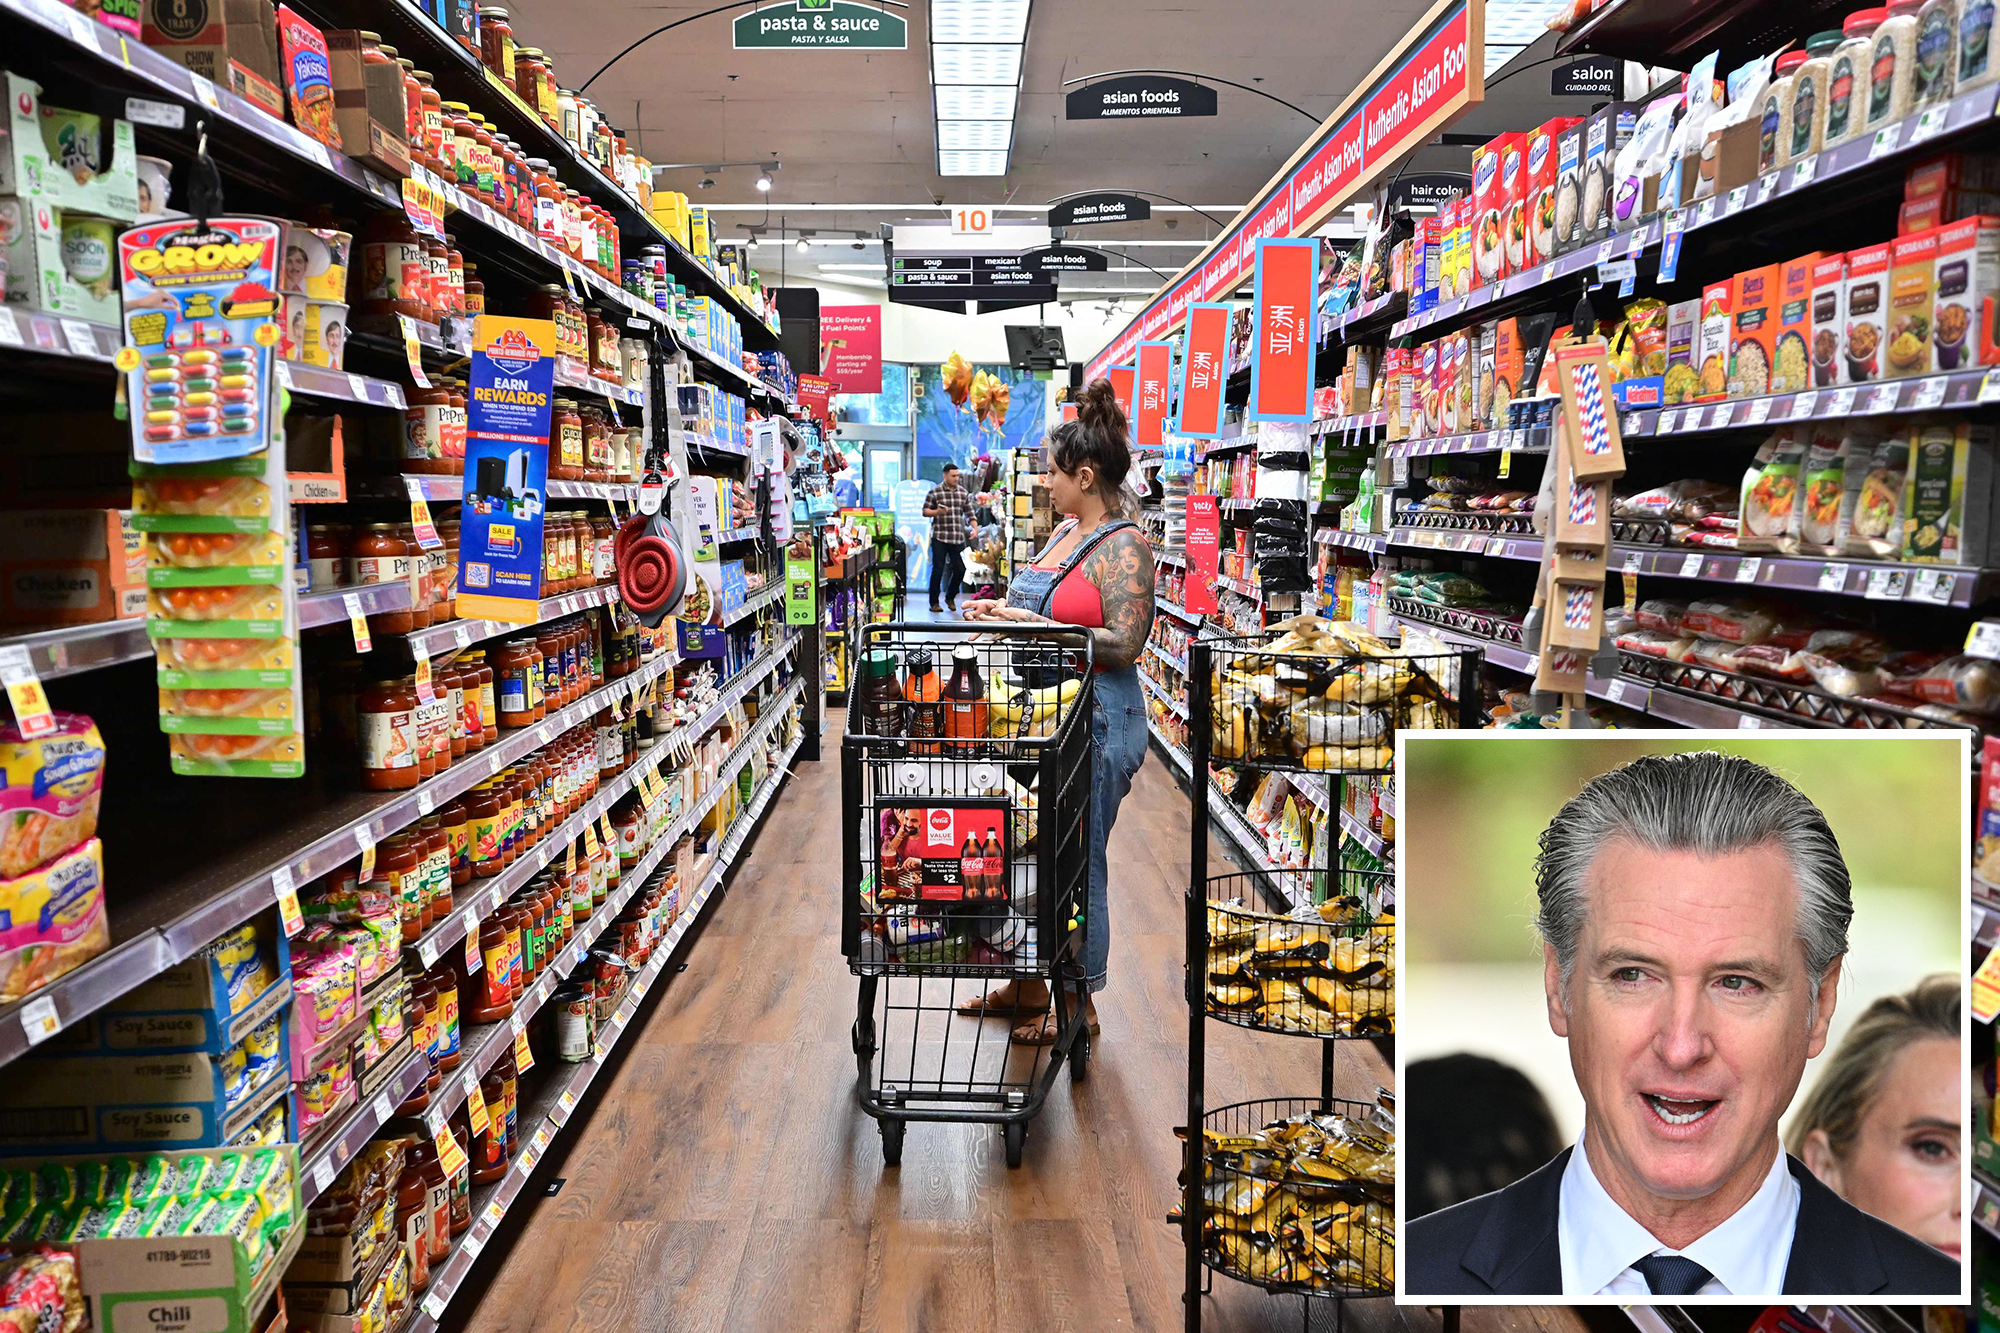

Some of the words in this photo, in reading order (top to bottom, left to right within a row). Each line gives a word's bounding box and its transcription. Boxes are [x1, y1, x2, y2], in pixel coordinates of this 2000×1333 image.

[167, 18, 195, 30] TRAYS
[760, 15, 807, 34] pasta
[812, 15, 827, 31] &
[831, 18, 880, 31] sauce
[791, 35, 816, 43] PASTA
[818, 35, 825, 43] Y
[825, 35, 850, 43] SALSA
[186, 51, 214, 66] CHOW
[1572, 66, 1614, 80] salon
[1565, 84, 1598, 92] CUIDADO
[1103, 91, 1138, 104] asian
[1141, 89, 1180, 103] foods
[1366, 90, 1409, 151] Authentic
[1410, 63, 1440, 113] Asian
[1443, 42, 1466, 85] Foo
[1101, 108, 1140, 116] ALIMENTOS
[1141, 107, 1181, 115] ORIENTALES
[1294, 169, 1322, 214] Authentic
[1323, 151, 1342, 189] Asian
[1343, 128, 1361, 170] Food
[1411, 184, 1434, 195] hair
[1073, 205, 1097, 216] asian
[1099, 202, 1126, 214] foods
[957, 210, 987, 231] 10
[1072, 216, 1099, 224] ALIMENTOS
[1100, 214, 1127, 222] ORIENTALES
[65, 242, 105, 254] SOON
[129, 241, 265, 274] GROW
[923, 259, 942, 267] soup
[1042, 256, 1062, 264] asian
[1064, 255, 1086, 263] foods
[907, 274, 928, 282] pasta
[991, 272, 1015, 280] asian
[1017, 272, 1033, 280] foods
[1269, 305, 1295, 356] 亚洲
[1297, 318, 1305, 343] Asian
[1192, 351, 1212, 390] 亚洲
[494, 377, 528, 391] EARN
[474, 387, 547, 406] REWARDS
[1144, 380, 1159, 410] 亚洲
[477, 432, 504, 440] MILLIONS
[510, 434, 539, 443] REWARDS
[304, 483, 328, 498] Chicken
[492, 527, 512, 535] SALE
[495, 571, 514, 579] SCAN
[145, 1112, 190, 1124] Sauce
[148, 1307, 191, 1322] Chili
